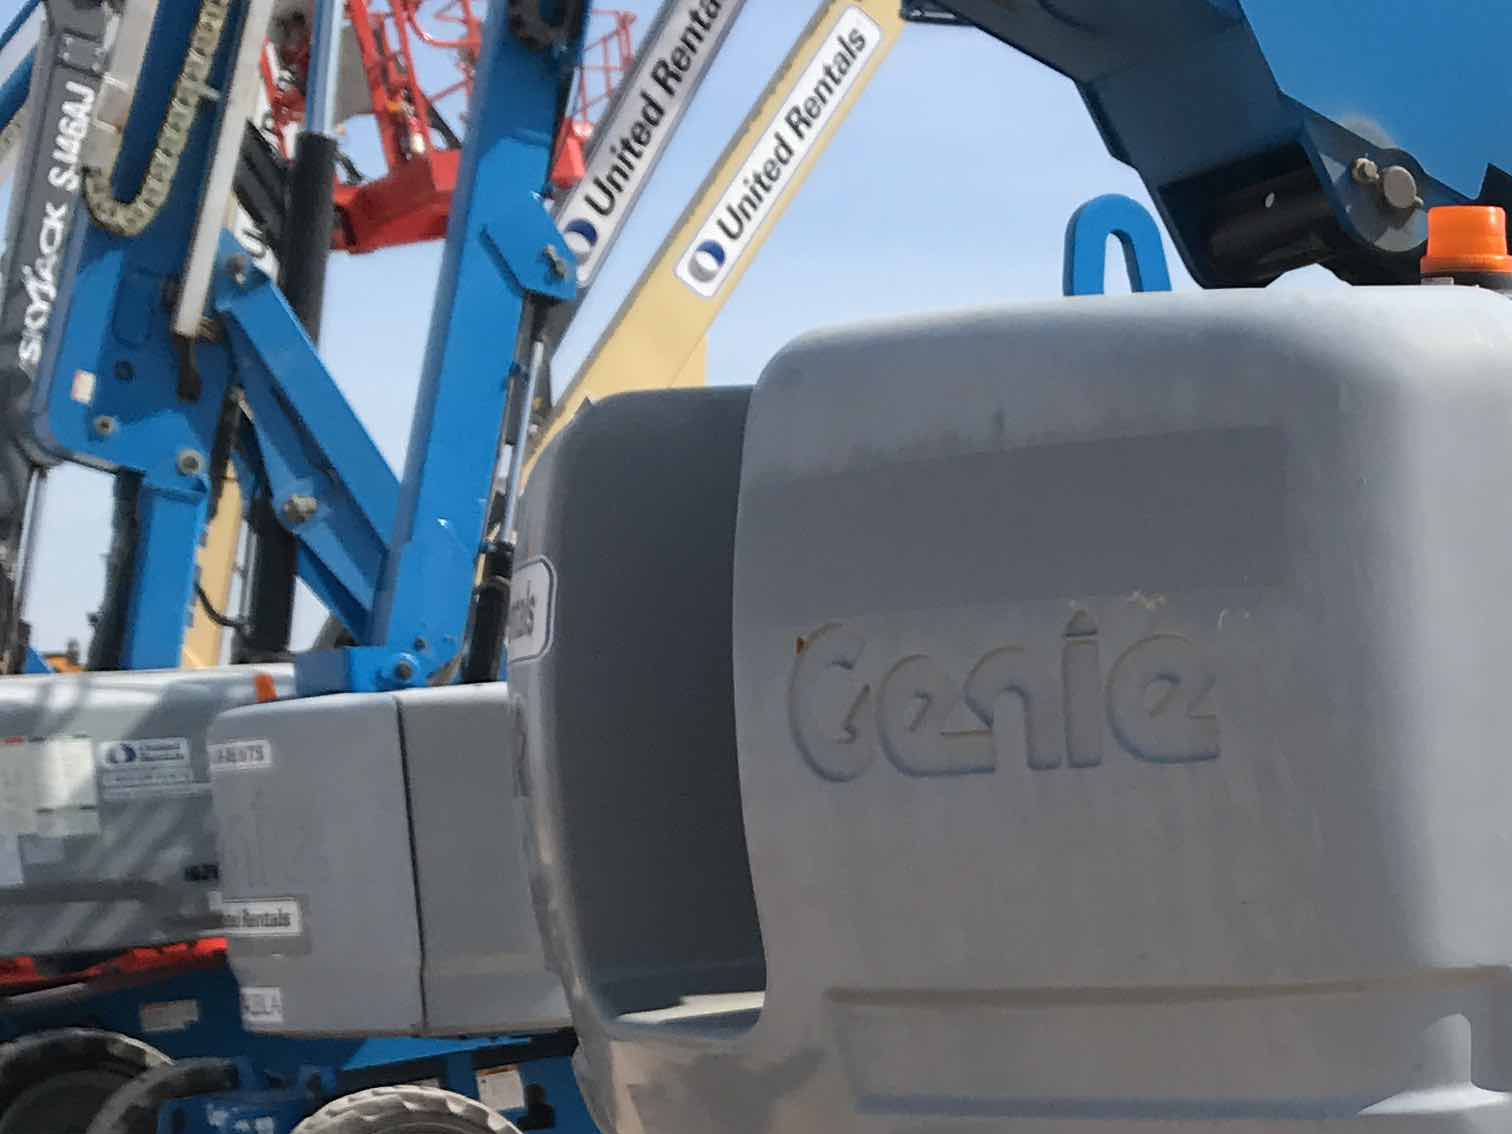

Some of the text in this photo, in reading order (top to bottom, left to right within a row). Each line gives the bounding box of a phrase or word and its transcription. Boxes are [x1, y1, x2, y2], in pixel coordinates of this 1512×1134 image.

[584, 91, 666, 218] United
[716, 27, 867, 242] United Rentals
[788, 608, 1221, 784] Genie
